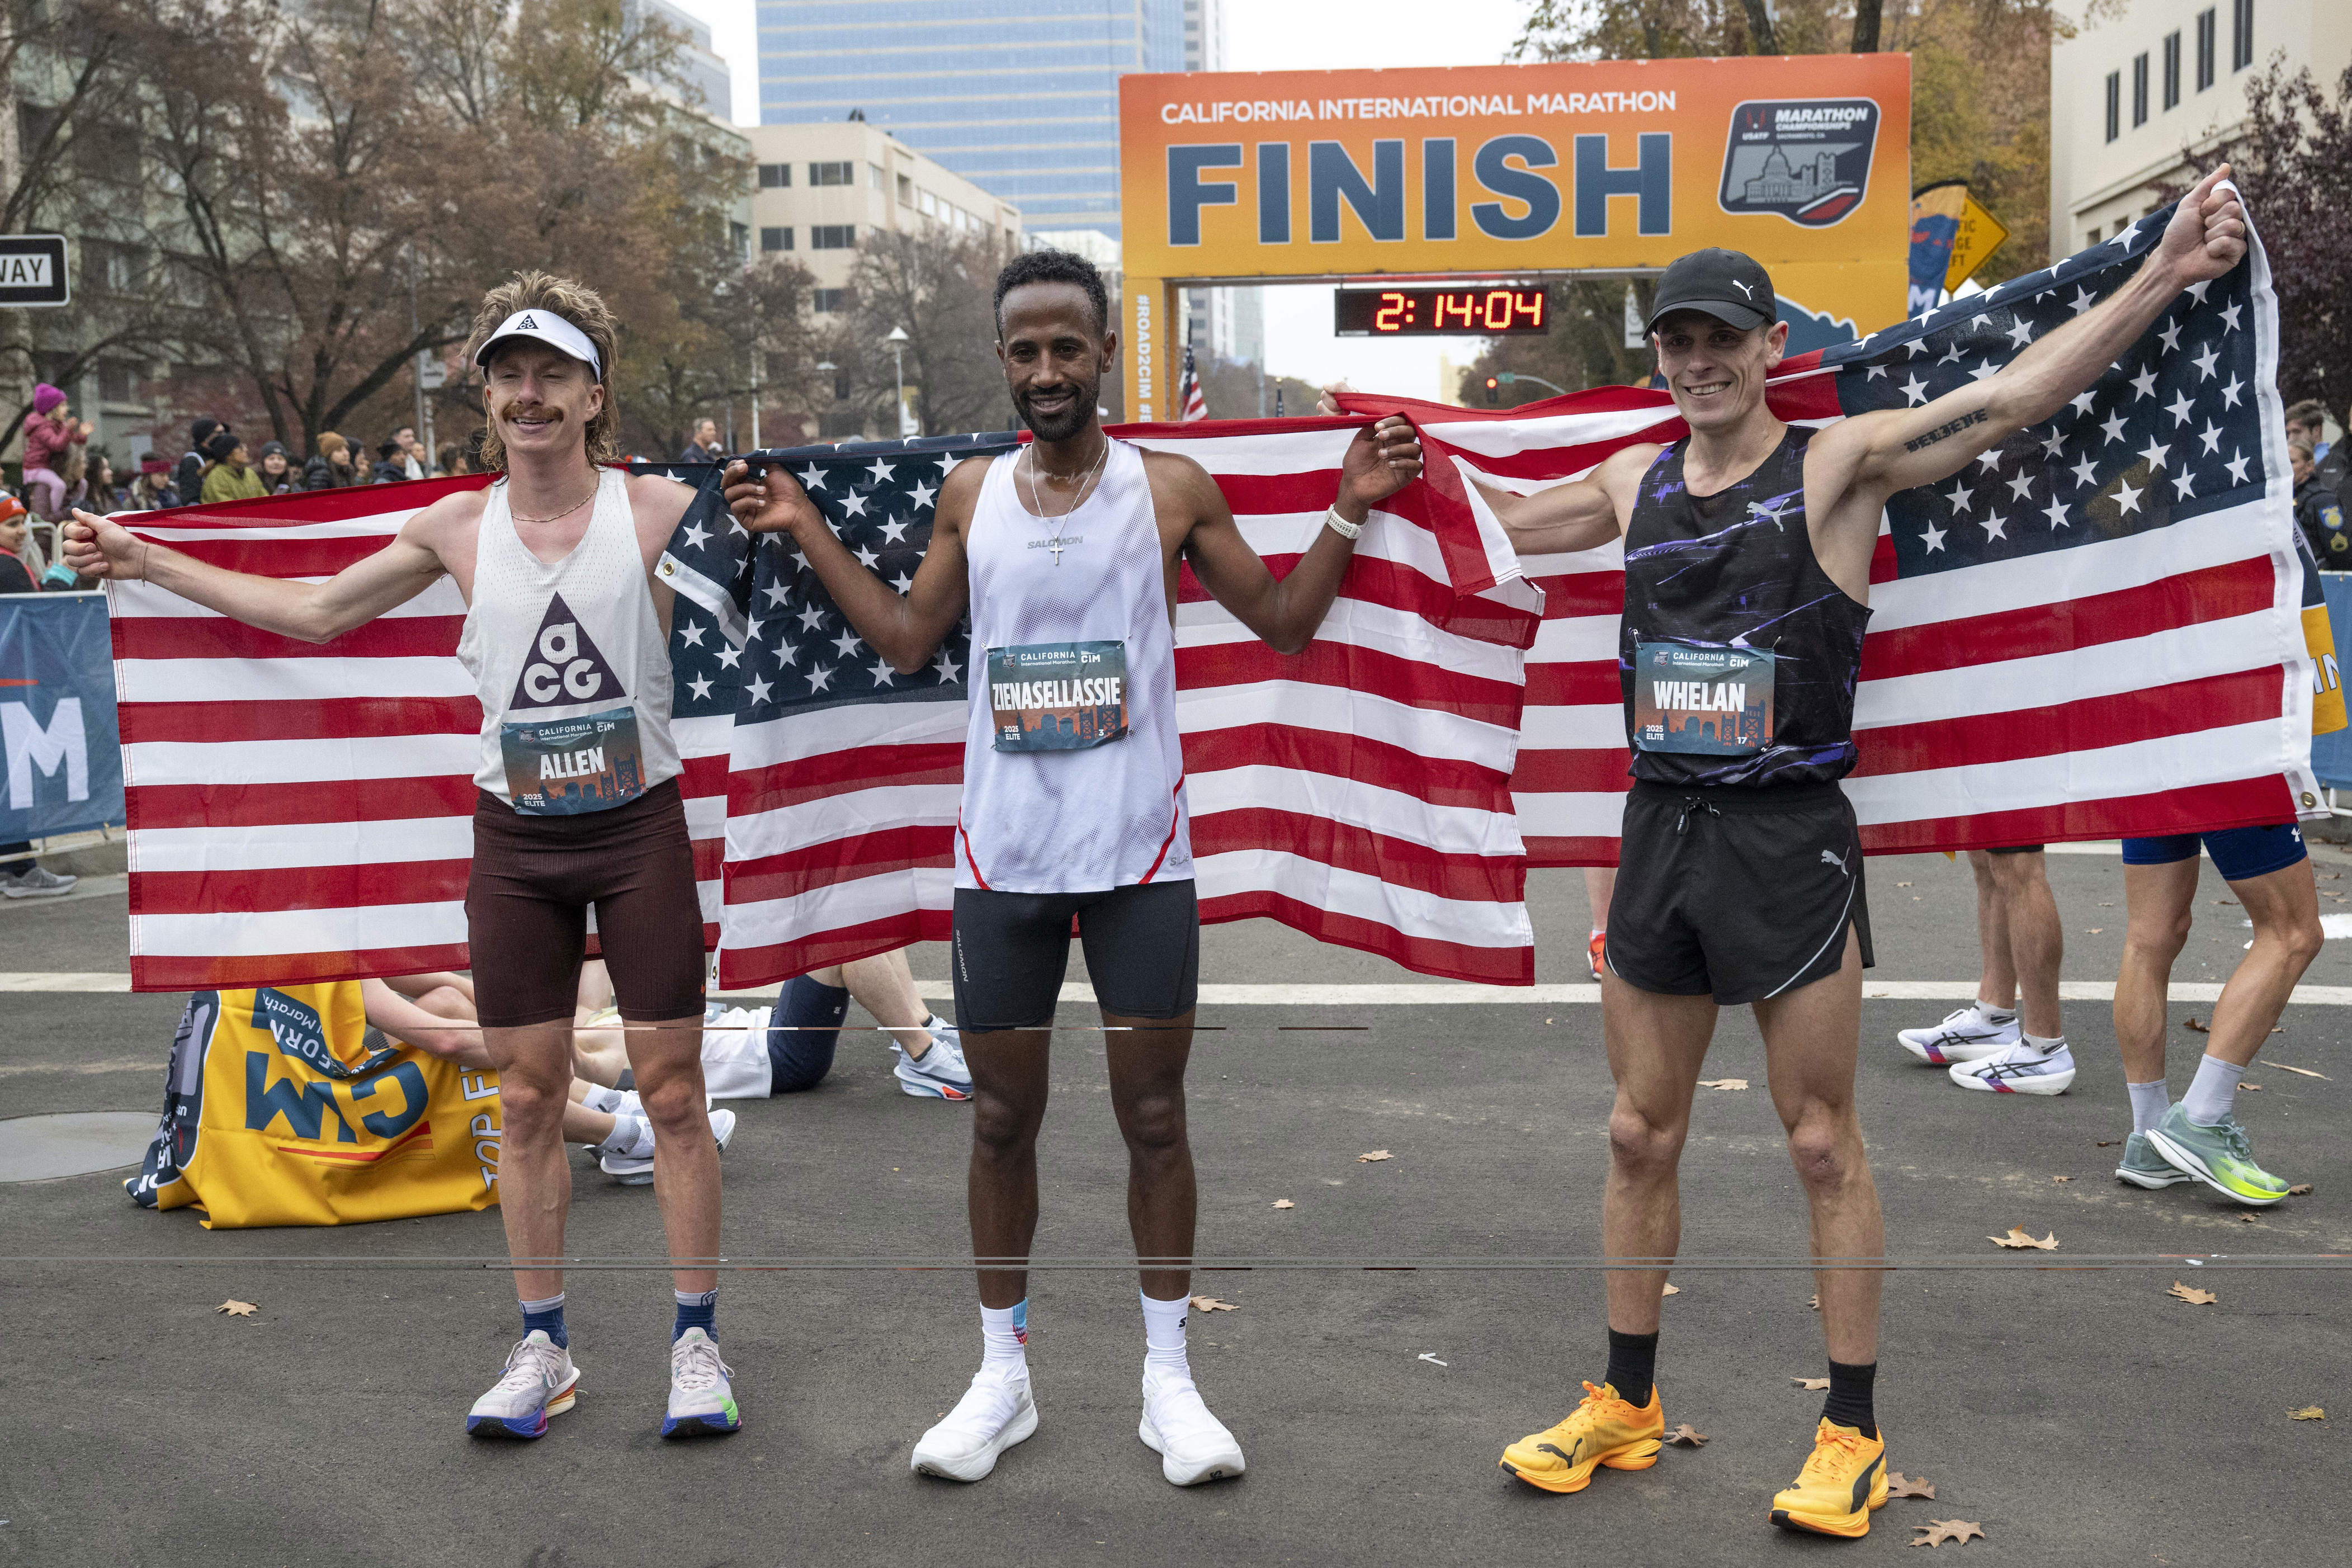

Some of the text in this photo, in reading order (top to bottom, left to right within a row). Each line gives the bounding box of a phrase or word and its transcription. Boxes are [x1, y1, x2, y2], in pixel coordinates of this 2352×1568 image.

[1161, 90, 1676, 124] CALIFORNIA INTERNATIONAL MARATHON
[1775, 107, 1868, 122] MARATHON
[1742, 132, 1769, 140] USATF
[1775, 121, 1852, 131] CHAMPIONSHIPS
[1166, 131, 1673, 248] FINISH
[1136, 294, 1152, 399] #ROAD2CIM
[1027, 536, 1083, 549] SALOMON
[1021, 651, 1101, 663] CALIFORNIA CIM
[1673, 652, 1749, 667] CALIFORNIA CIM
[993, 677, 1121, 711] ZIENASELLASSIE
[1653, 681, 1746, 712] WHELAN
[539, 722, 615, 736] CALIFORNIA CIM
[540, 747, 606, 780] ALLEN
[956, 929, 969, 982] SALOMON
[262, 993, 317, 1030] Marath
[245, 1050, 429, 1144] CIM
